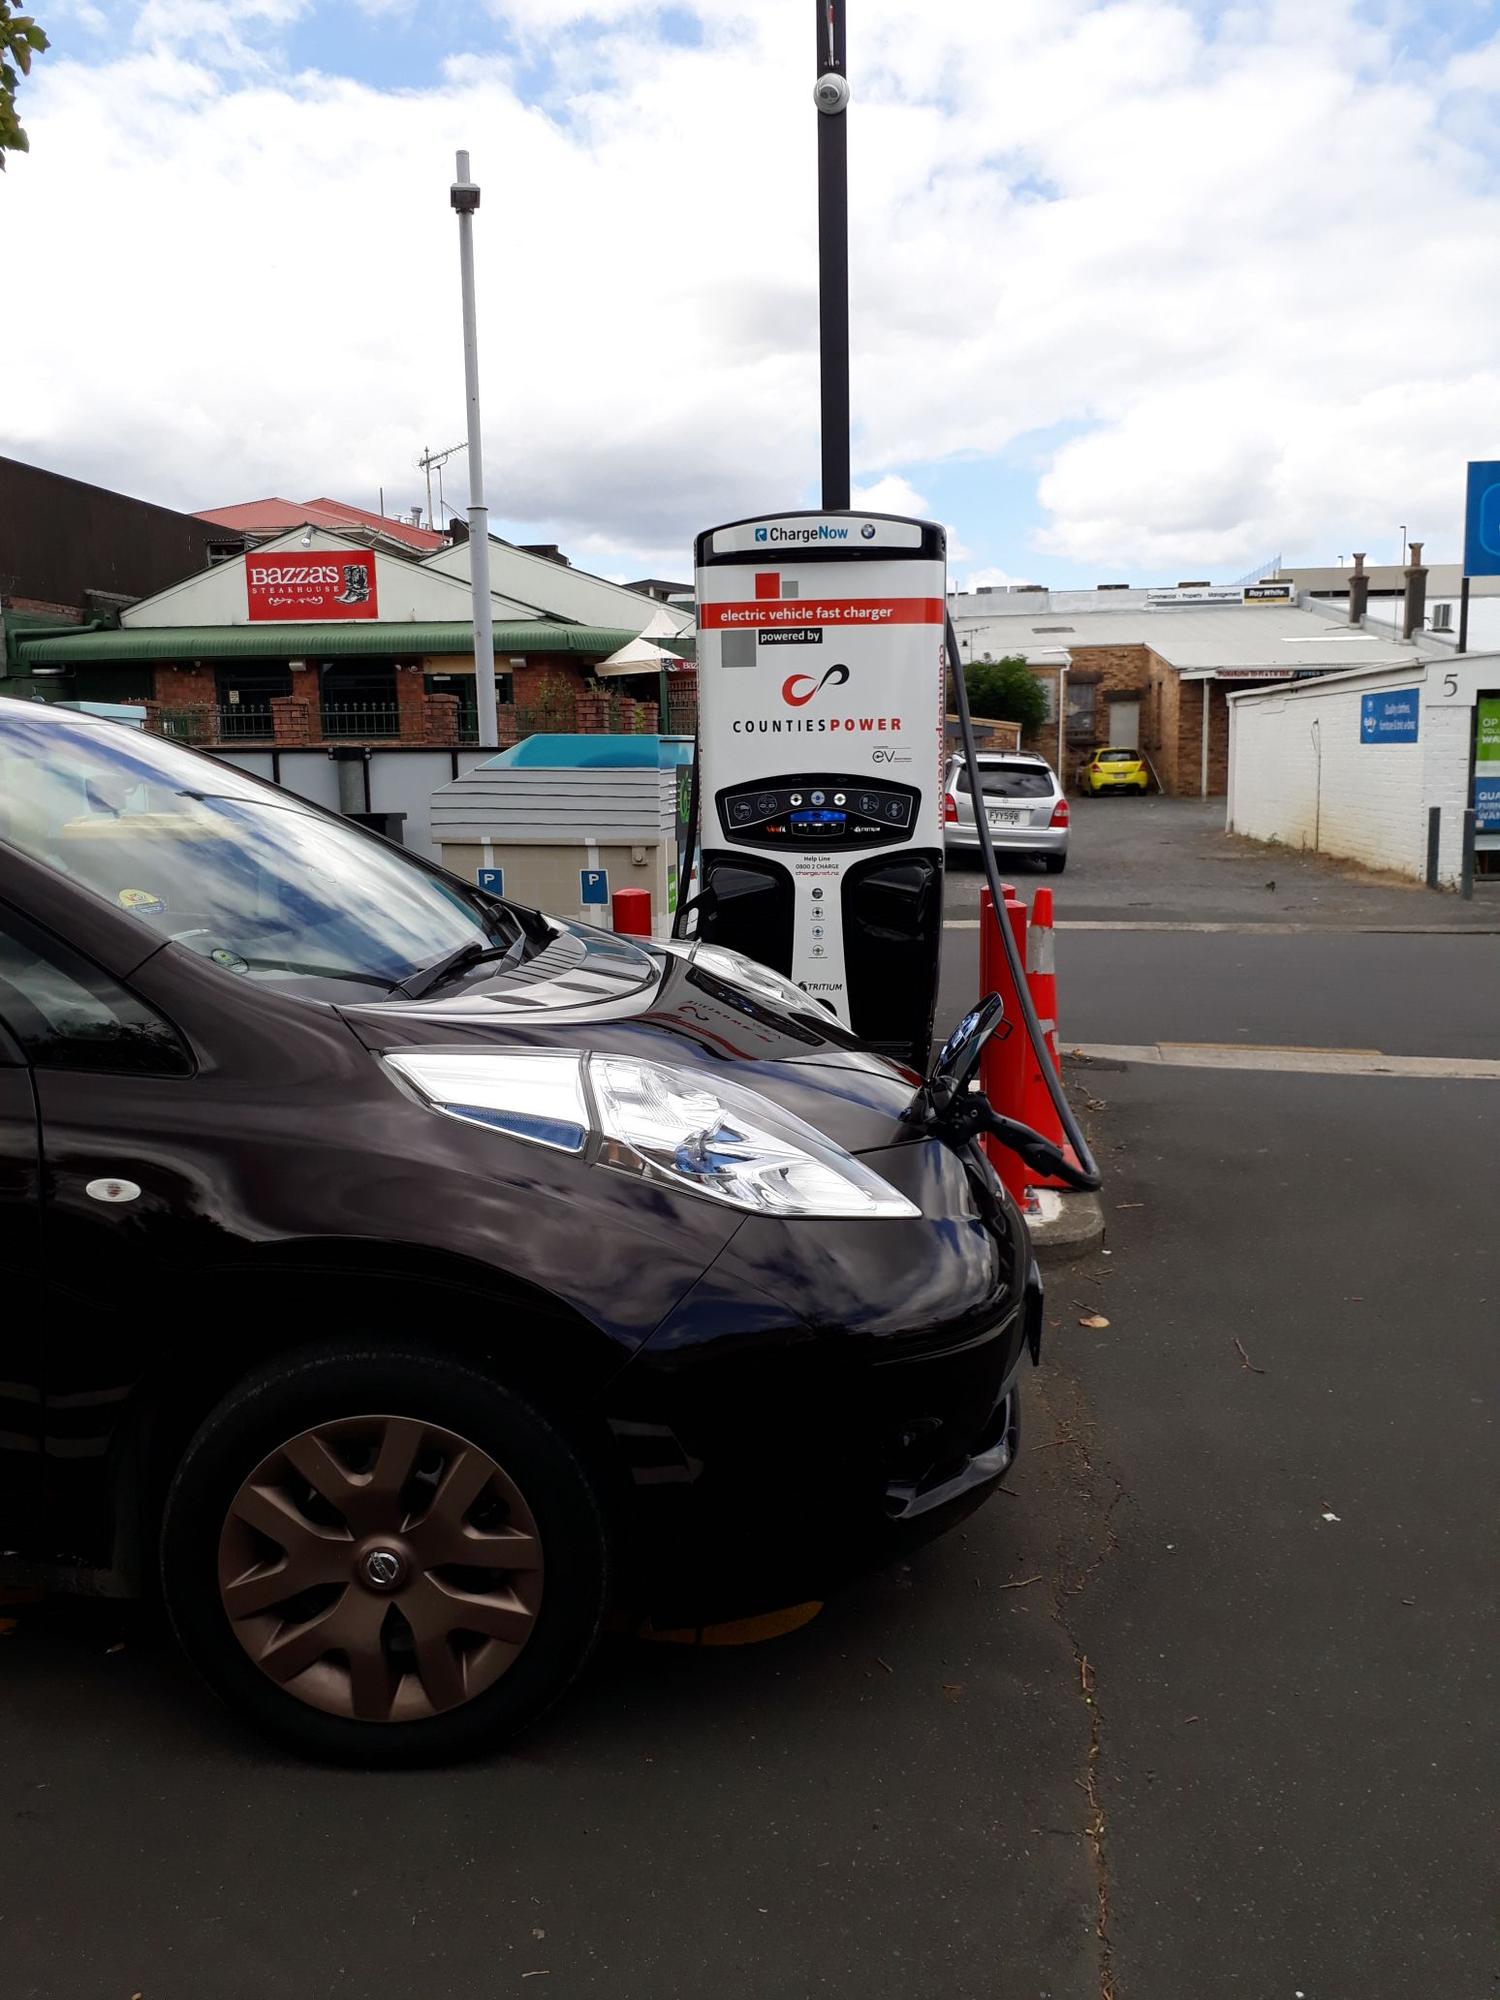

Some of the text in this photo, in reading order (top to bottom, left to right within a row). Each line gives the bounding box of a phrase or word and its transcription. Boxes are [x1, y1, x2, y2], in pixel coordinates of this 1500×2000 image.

[770, 526, 848, 543] ChargeNow
[251, 585, 340, 594] STEAKHOUSE
[1249, 589, 1263, 597] Ray
[720, 605, 892, 622] electric vehicle fast charger
[761, 630, 820, 643] powered by
[1443, 673, 1458, 697] 5
[732, 717, 901, 734] COUNTIESPOWER
[484, 873, 495, 885] P
[588, 873, 600, 886] P
[807, 983, 843, 992] TRITIUM
